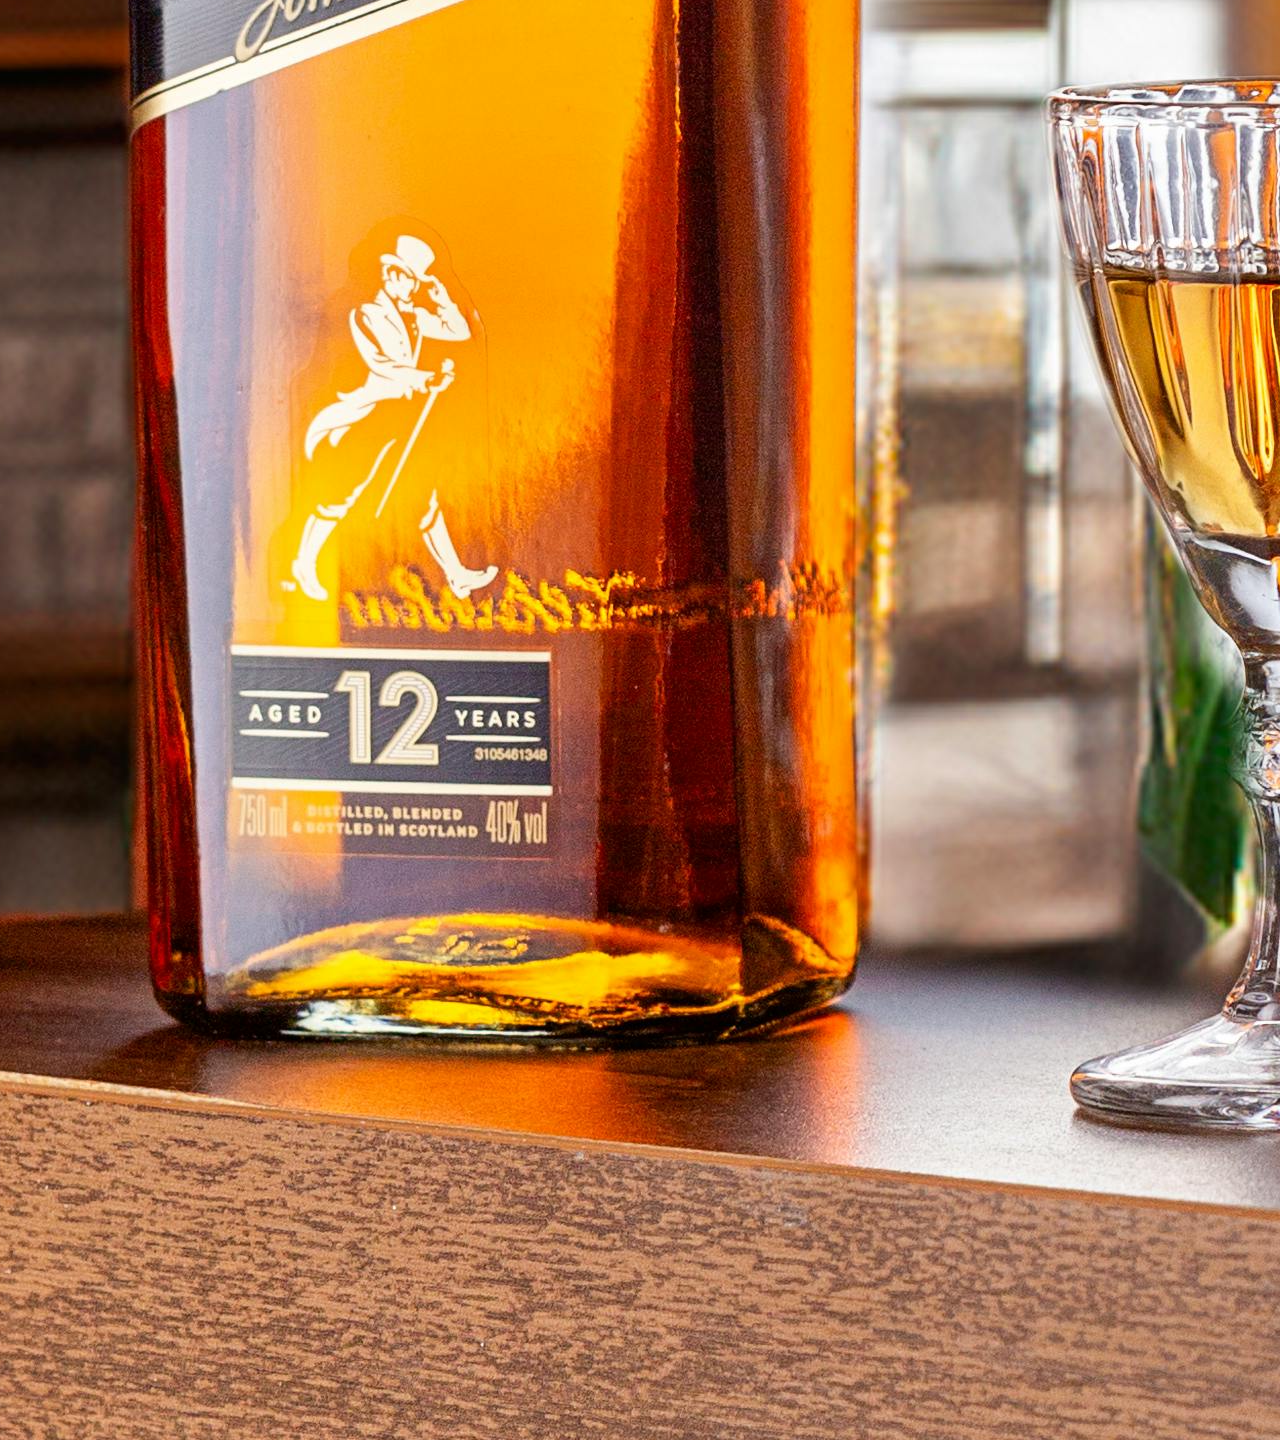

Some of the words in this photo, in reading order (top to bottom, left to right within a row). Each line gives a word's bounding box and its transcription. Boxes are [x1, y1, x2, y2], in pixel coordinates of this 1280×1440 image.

[248, 704, 322, 723] AGED
[333, 670, 439, 766] 12
[455, 710, 536, 728] YEARS
[238, 794, 267, 837] 750
[270, 795, 288, 838] ml
[306, 822, 374, 836] BOTTLED
[378, 824, 395, 836] IN
[399, 825, 479, 839] SCOTLAND
[307, 805, 389, 819] DISTILLED,
[392, 807, 463, 821] BLENDED
[486, 799, 521, 844] 40%
[524, 802, 548, 843] vol
